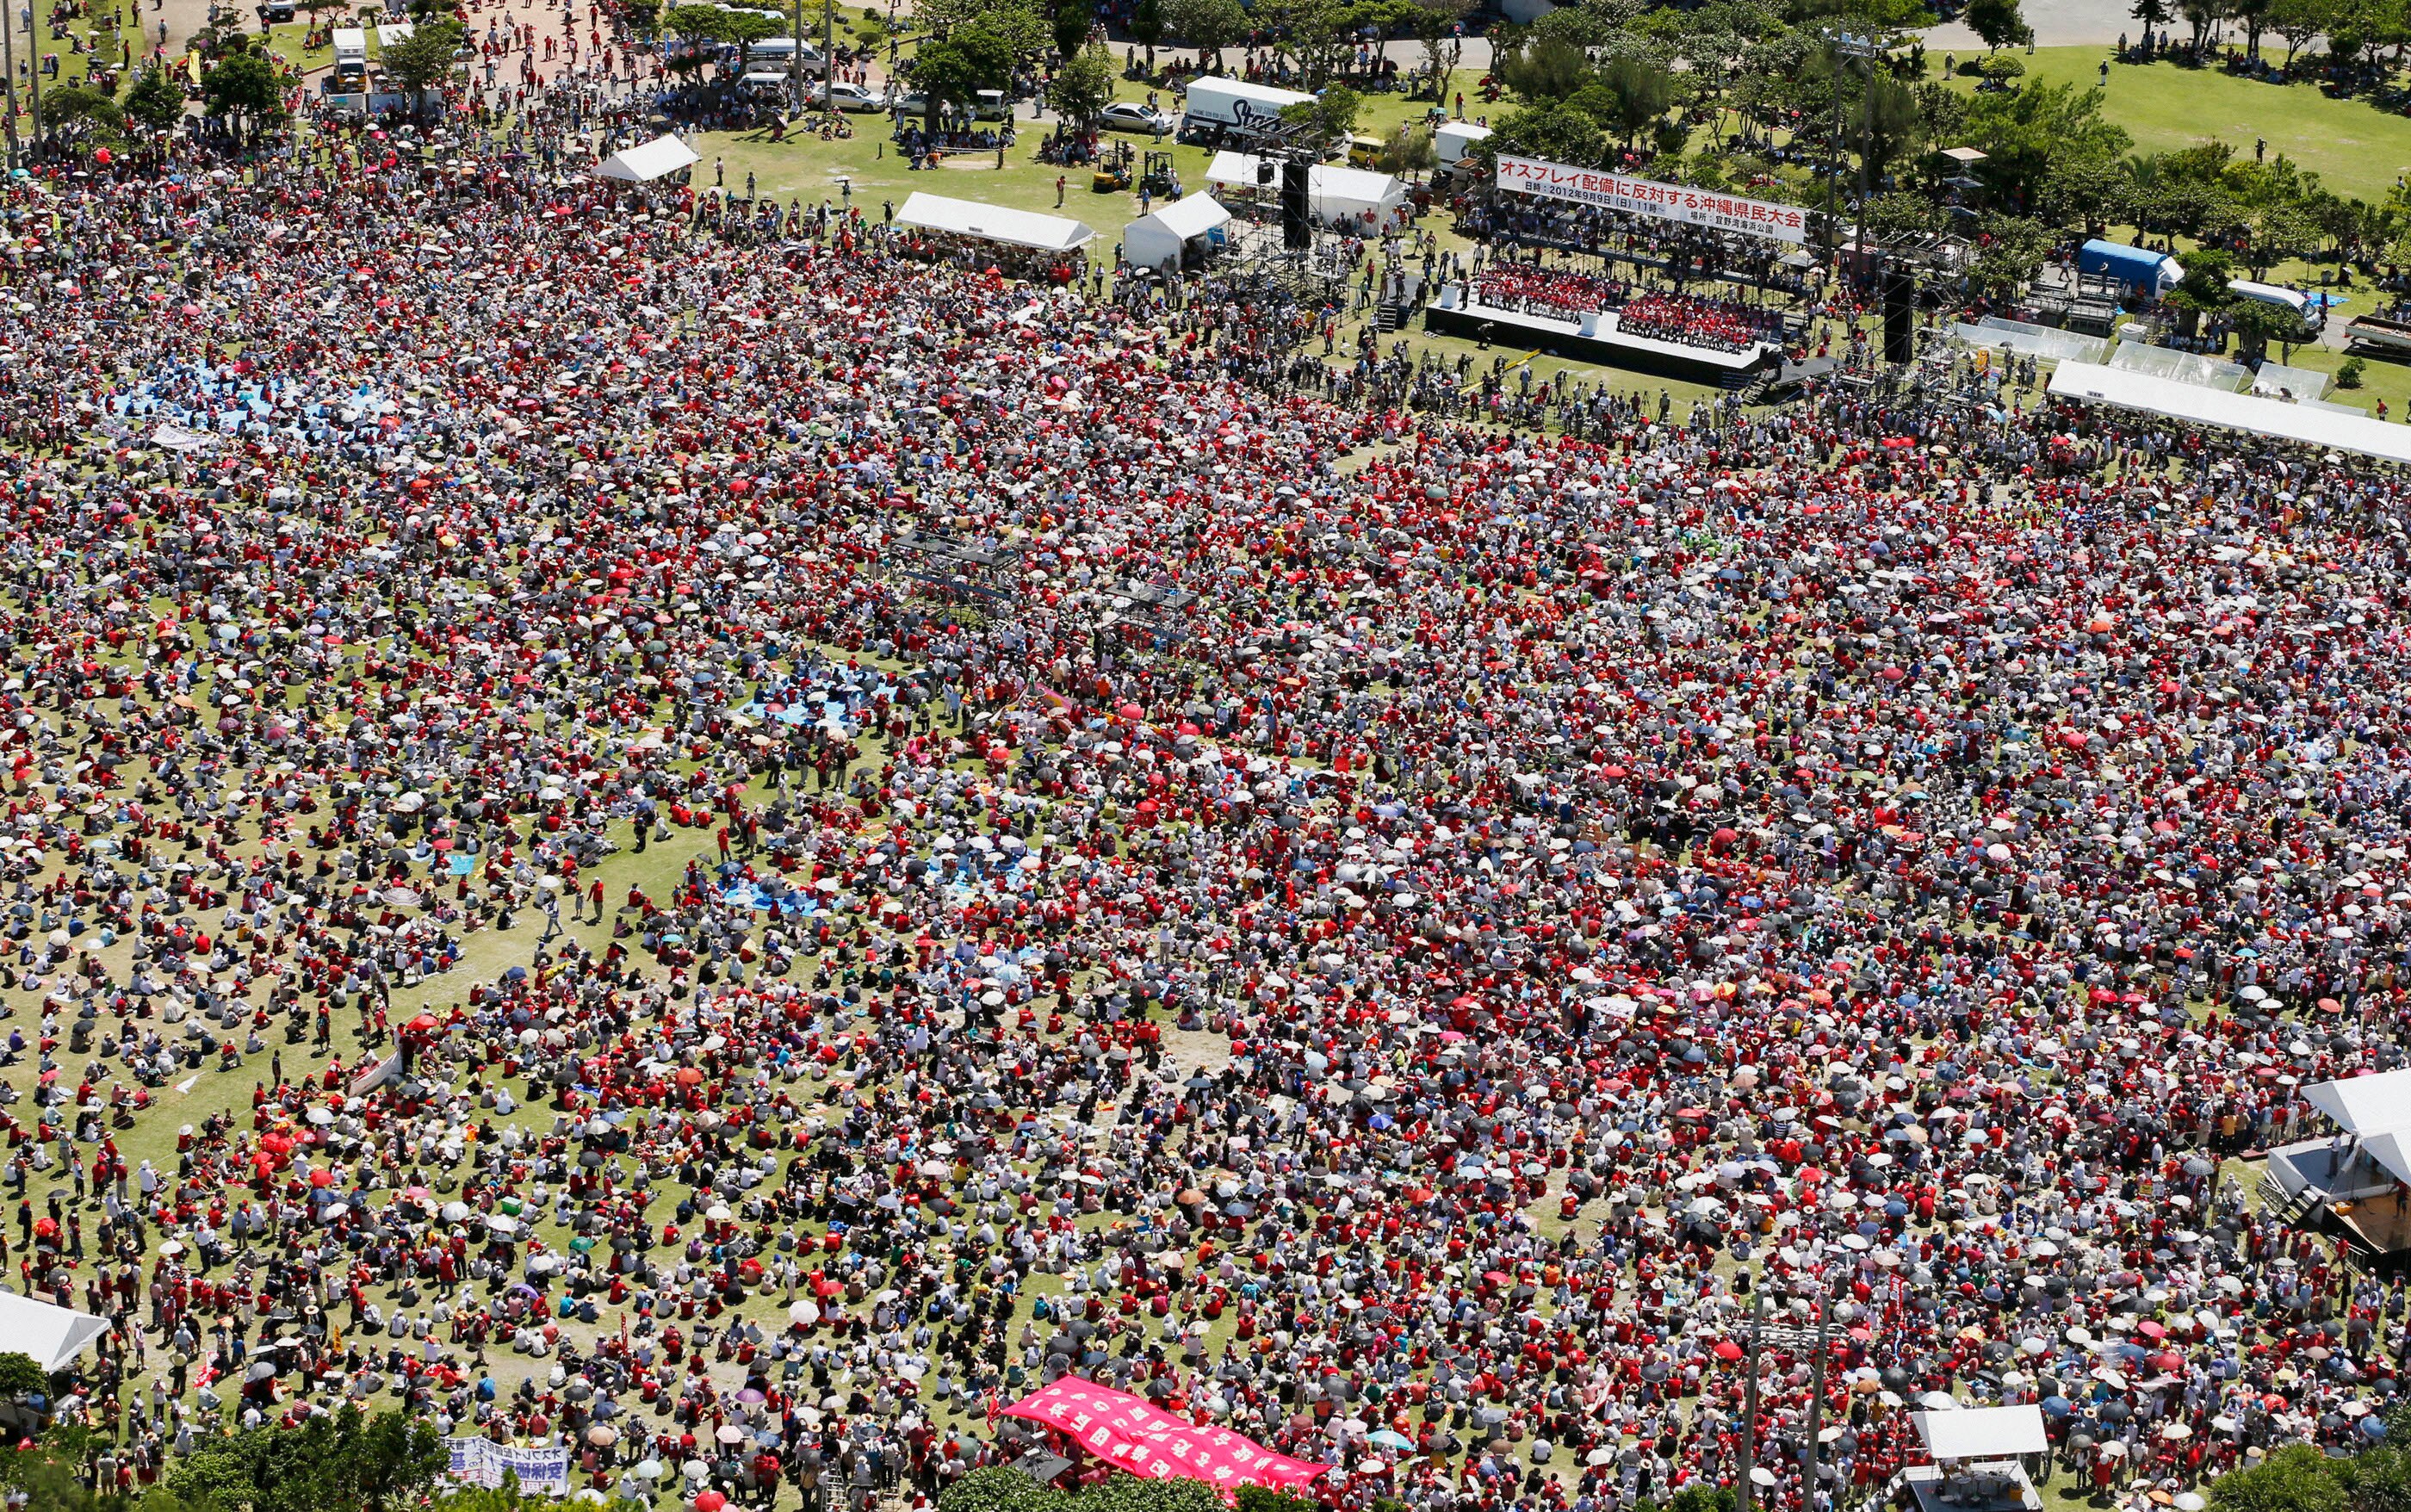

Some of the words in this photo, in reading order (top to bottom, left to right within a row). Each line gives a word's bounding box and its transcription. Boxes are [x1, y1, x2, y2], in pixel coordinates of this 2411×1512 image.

[1501, 161, 1801, 228] オスプレイ配備に反対する沖縄県民大会
